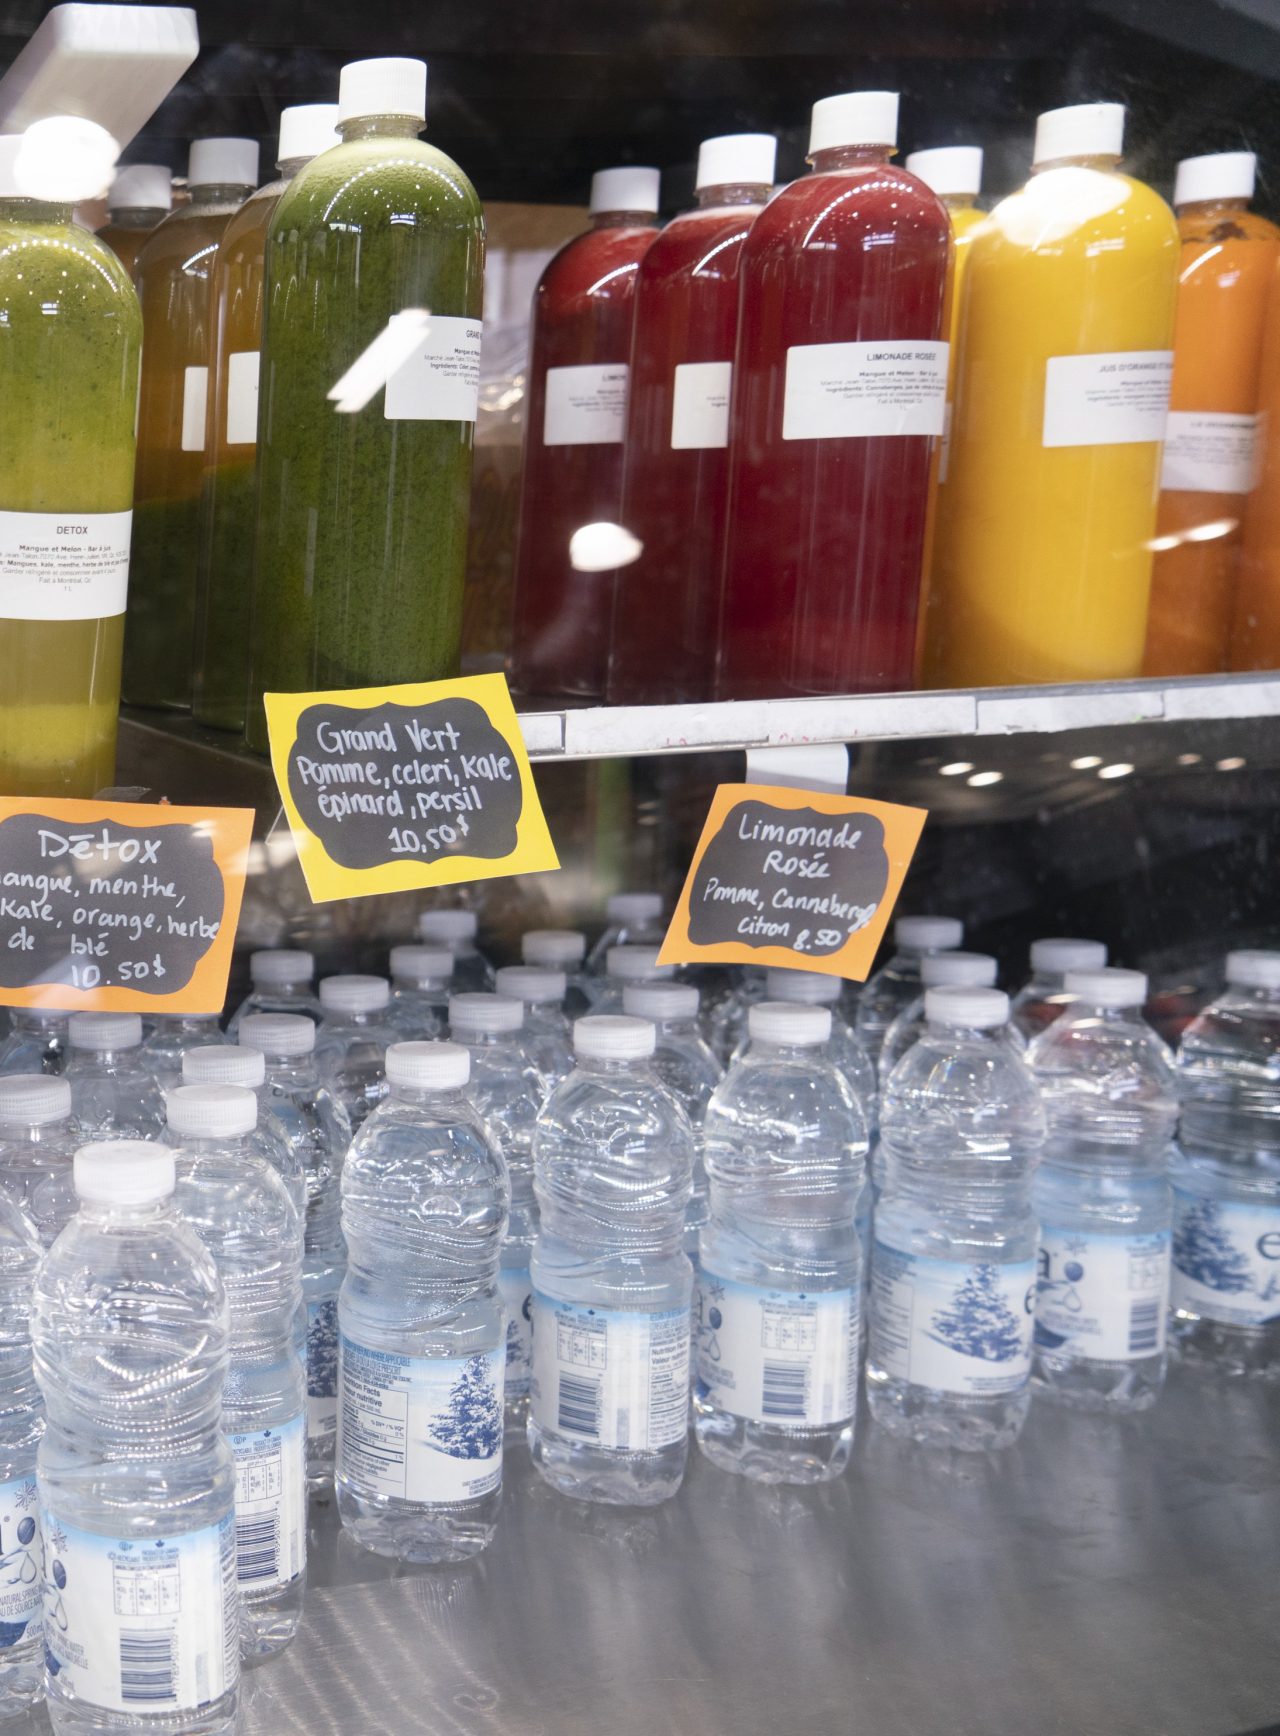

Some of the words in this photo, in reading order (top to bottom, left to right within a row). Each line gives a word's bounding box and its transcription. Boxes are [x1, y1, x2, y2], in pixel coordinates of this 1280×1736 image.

[867, 353, 912, 361] LIMONADE
[56, 526, 88, 535] DETOX
[19, 544, 49, 552] Mangue
[317, 722, 397, 755] Grand
[405, 719, 460, 753] Vert
[296, 755, 390, 789] Pomme,
[417, 785, 483, 819] persil
[738, 813, 863, 849] Limonade
[763, 850, 830, 878] Rosée
[88, 874, 187, 908] menthe,
[703, 876, 764, 911] Pomme,
[72, 906, 163, 940] orange,
[167, 914, 220, 940] herbe
[7, 926, 35, 951] de
[70, 932, 109, 956] blé
[793, 929, 841, 950] 8.50
[364, 1384, 381, 1397] Facts
[7, 1605, 14, 1616] DE
